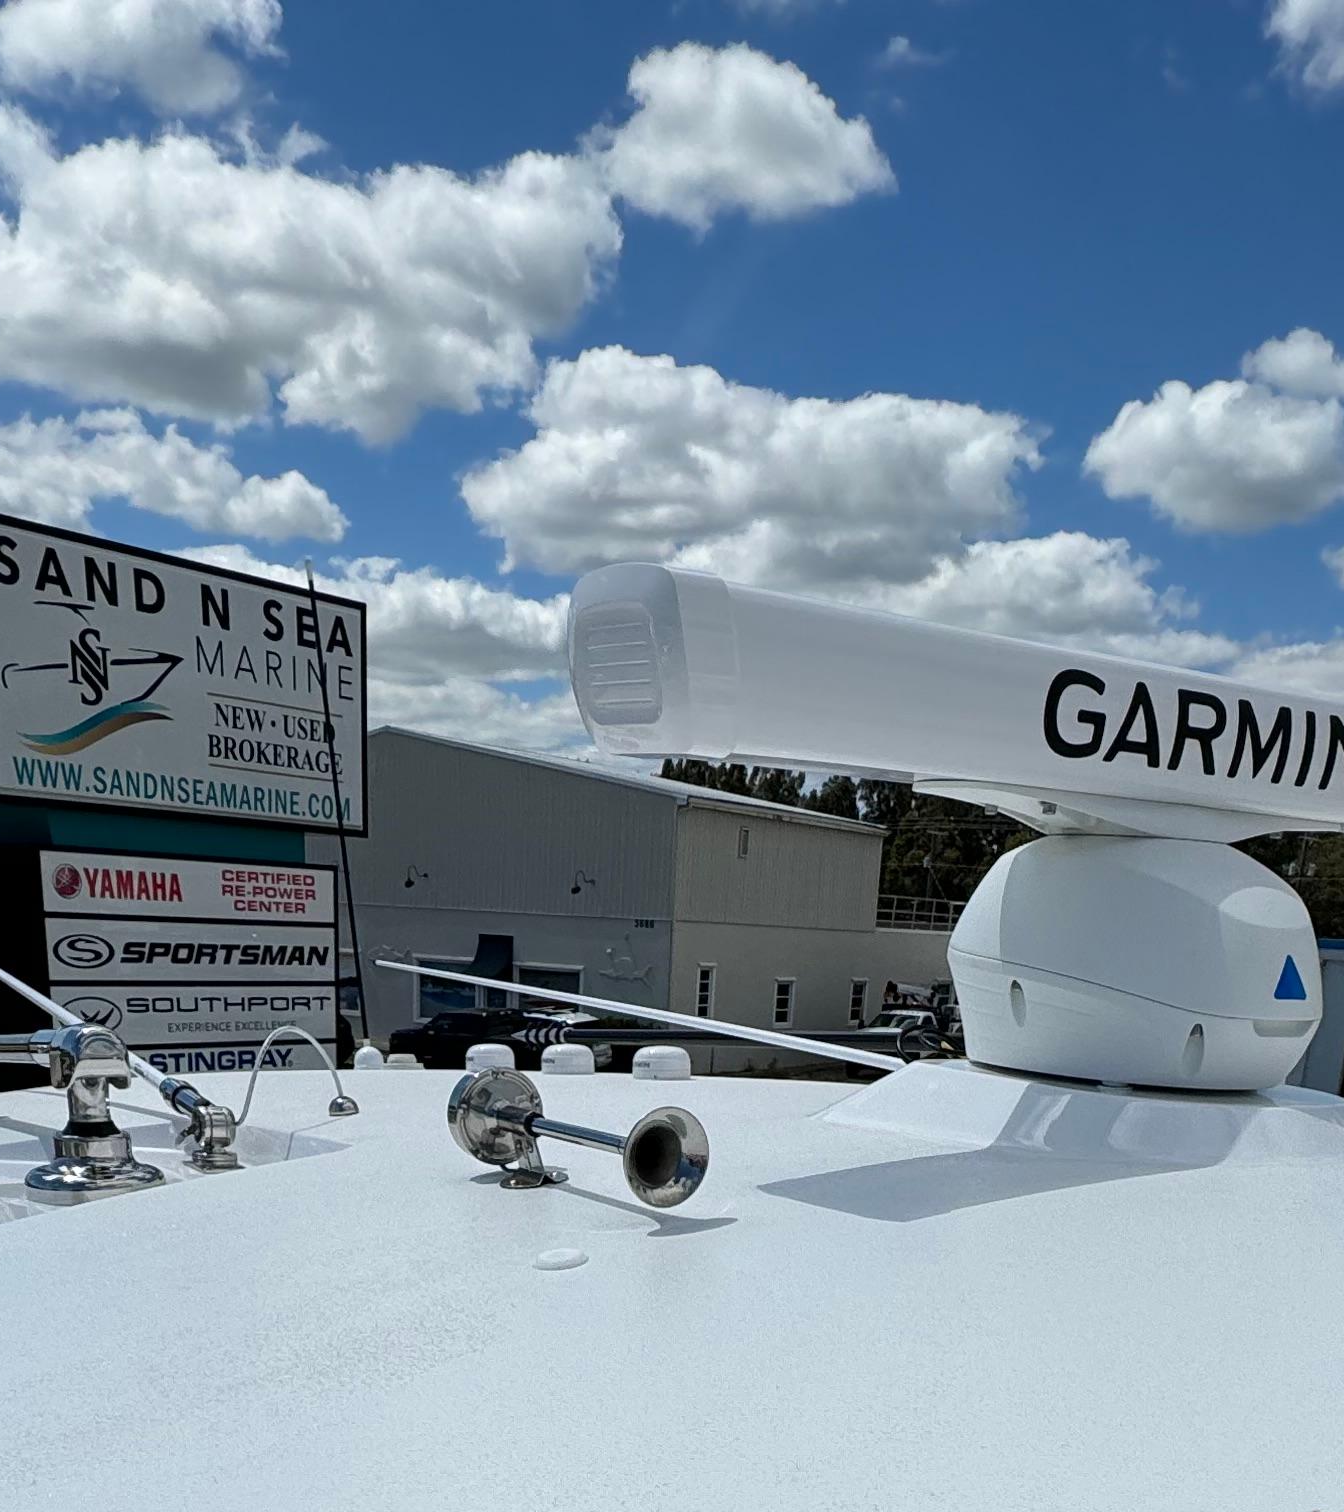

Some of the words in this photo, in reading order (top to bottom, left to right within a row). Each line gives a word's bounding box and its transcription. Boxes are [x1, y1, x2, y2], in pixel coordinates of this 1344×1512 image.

[200, 584, 231, 631] N
[262, 599, 354, 657] SEA
[195, 635, 354, 701] MARINE
[213, 702, 267, 734] NEW
[282, 714, 336, 744] USED
[207, 733, 344, 776] BROKERAGE
[12, 756, 351, 822] WWW.SANDNSEAMARINE.COM
[82, 867, 184, 902] YAMAHA
[221, 869, 316, 887] CERTIFIED
[221, 884, 317, 901] RE-POWER
[233, 900, 307, 914] CENTER
[120, 941, 330, 966] SPORTSMAN
[126, 996, 332, 1014] SOUTHPORT
[167, 1022, 232, 1033] EXPERIENCE
[149, 1047, 294, 1074] STINGRAY
